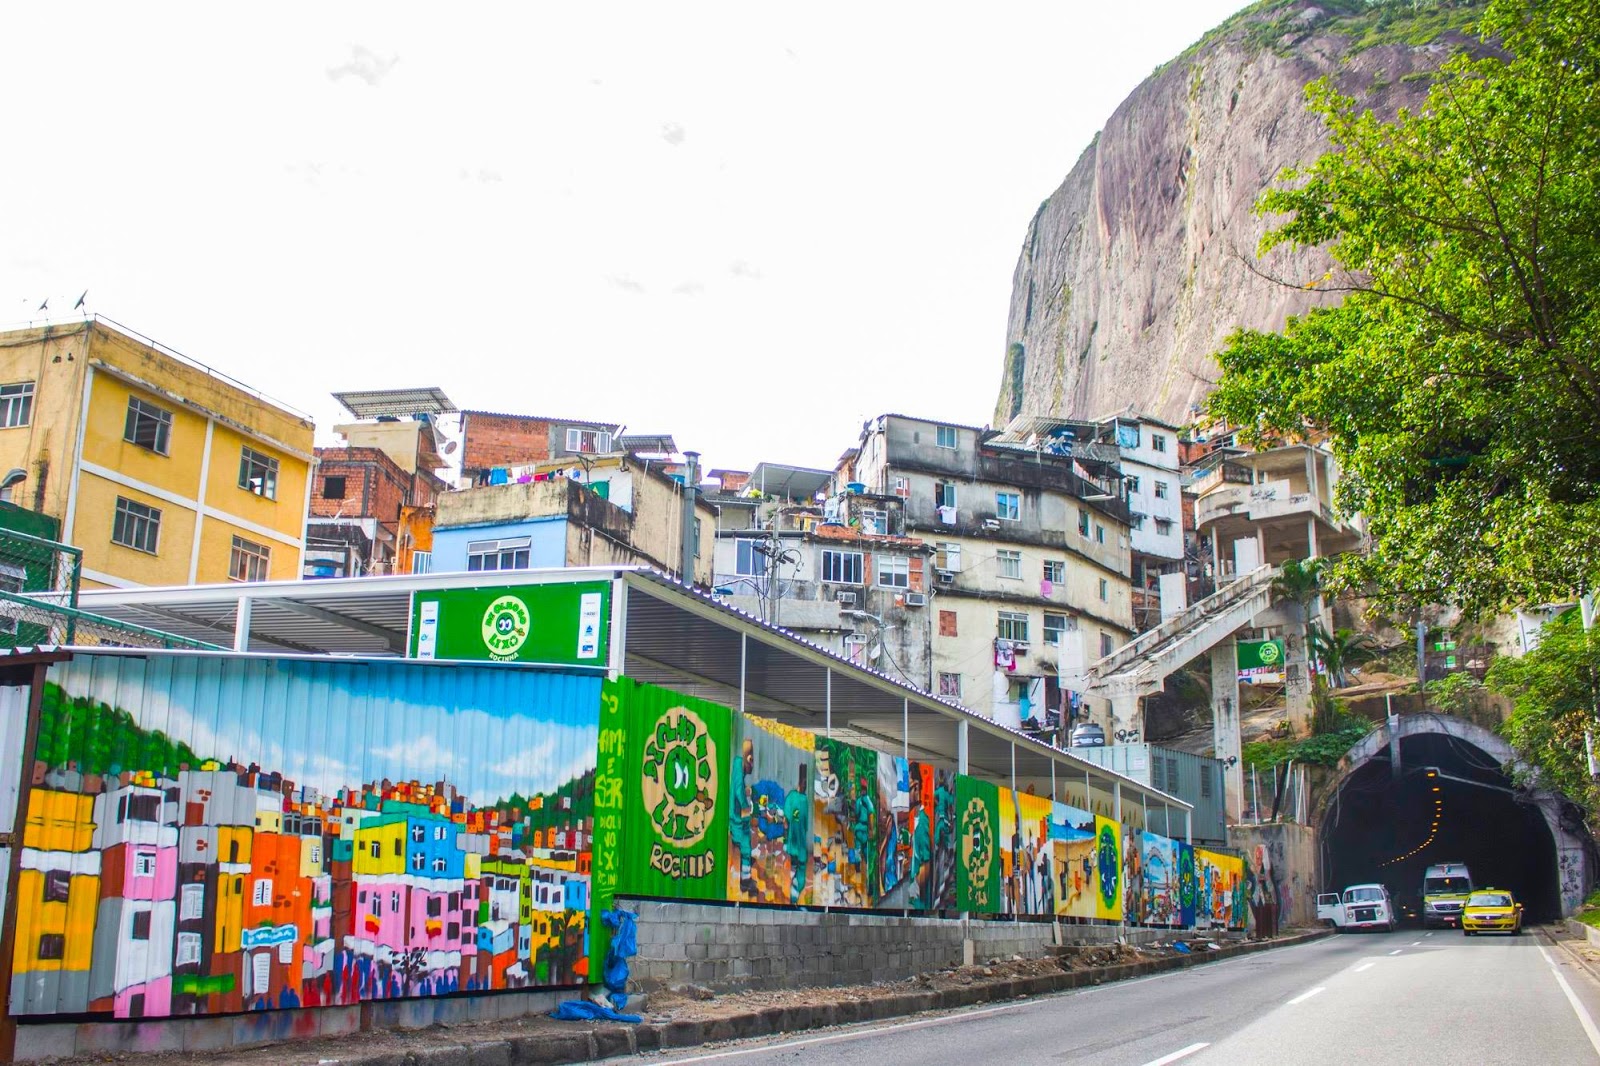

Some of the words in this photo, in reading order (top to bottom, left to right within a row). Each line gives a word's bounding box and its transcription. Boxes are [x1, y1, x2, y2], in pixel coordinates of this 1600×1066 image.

[493, 601, 519, 615] OLHO
[488, 633, 519, 650] LIXO
[488, 651, 520, 662] ROCINHA
